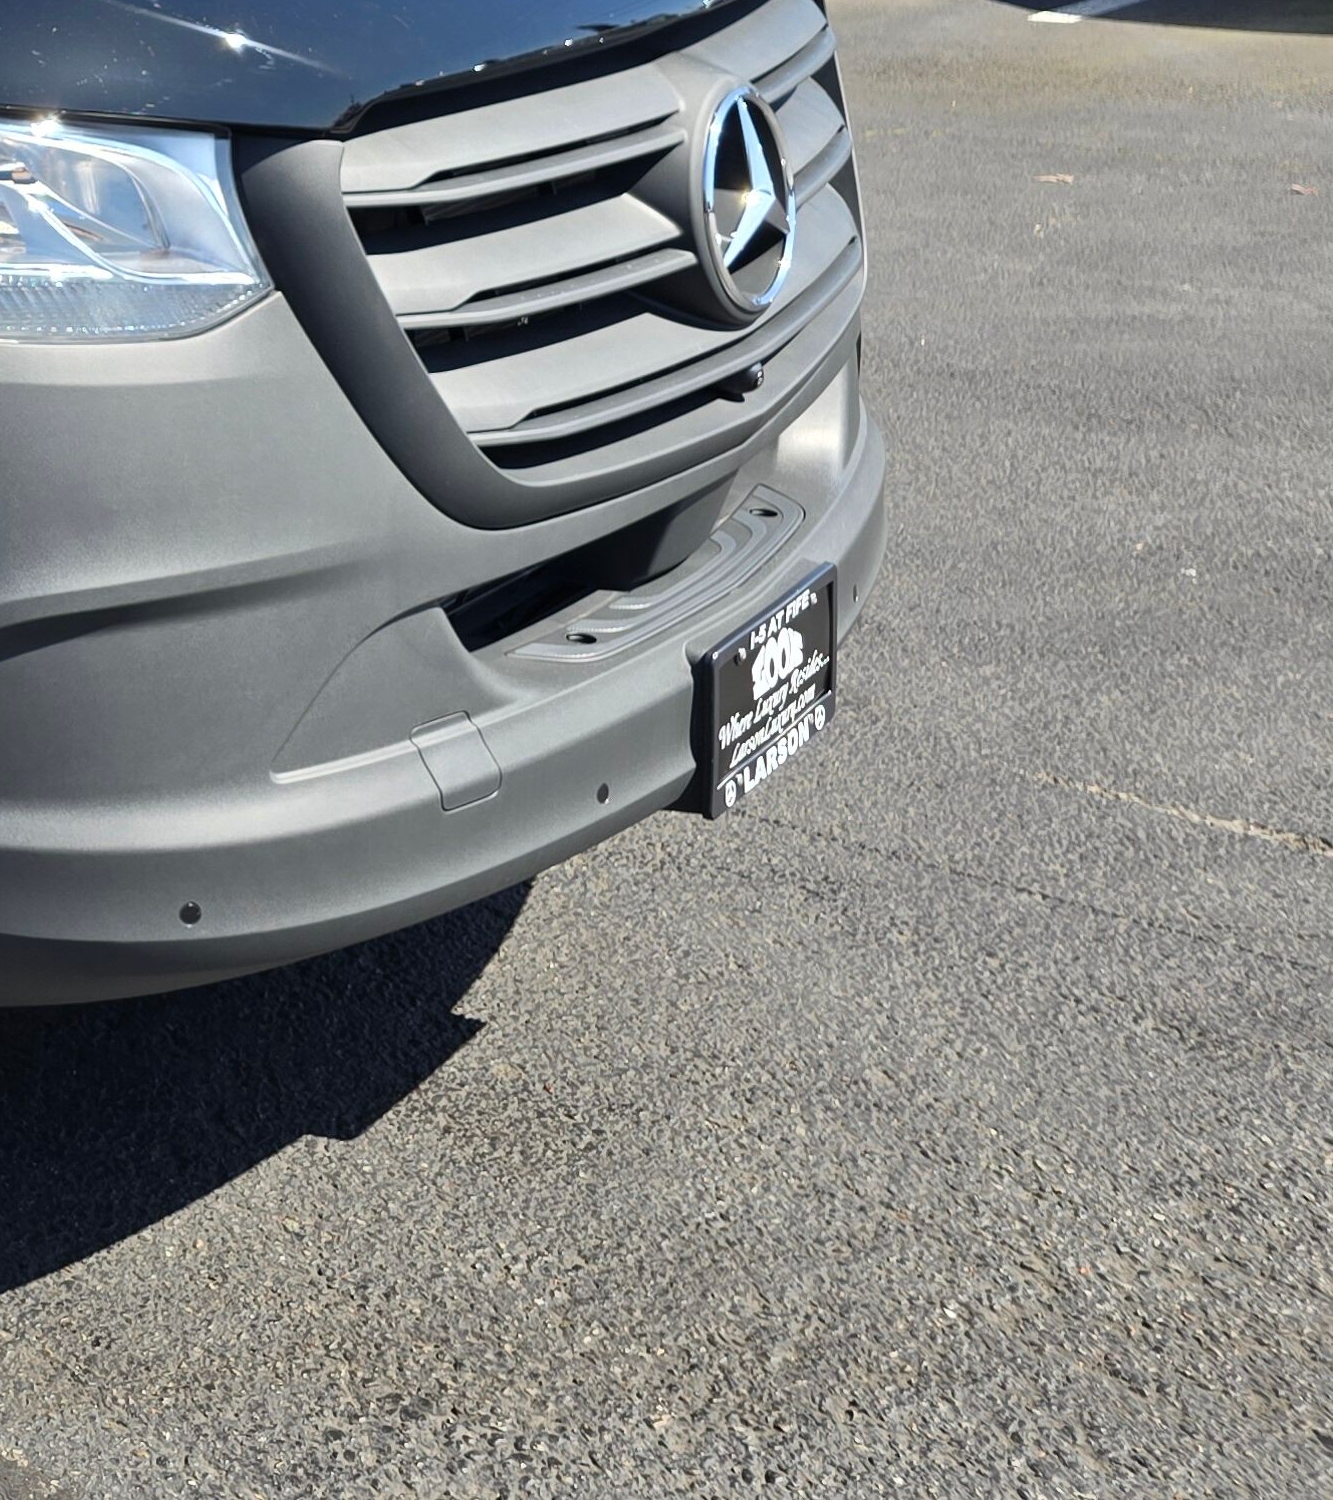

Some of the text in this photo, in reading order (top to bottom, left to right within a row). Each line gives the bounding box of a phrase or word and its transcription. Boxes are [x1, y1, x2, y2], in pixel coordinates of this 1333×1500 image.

[750, 588, 811, 650] I-5 AT FIFE
[718, 712, 753, 750] Where
[753, 681, 789, 724] Luxury
[729, 683, 816, 769] LarsonLuxury.com
[743, 716, 810, 794] LARSON
